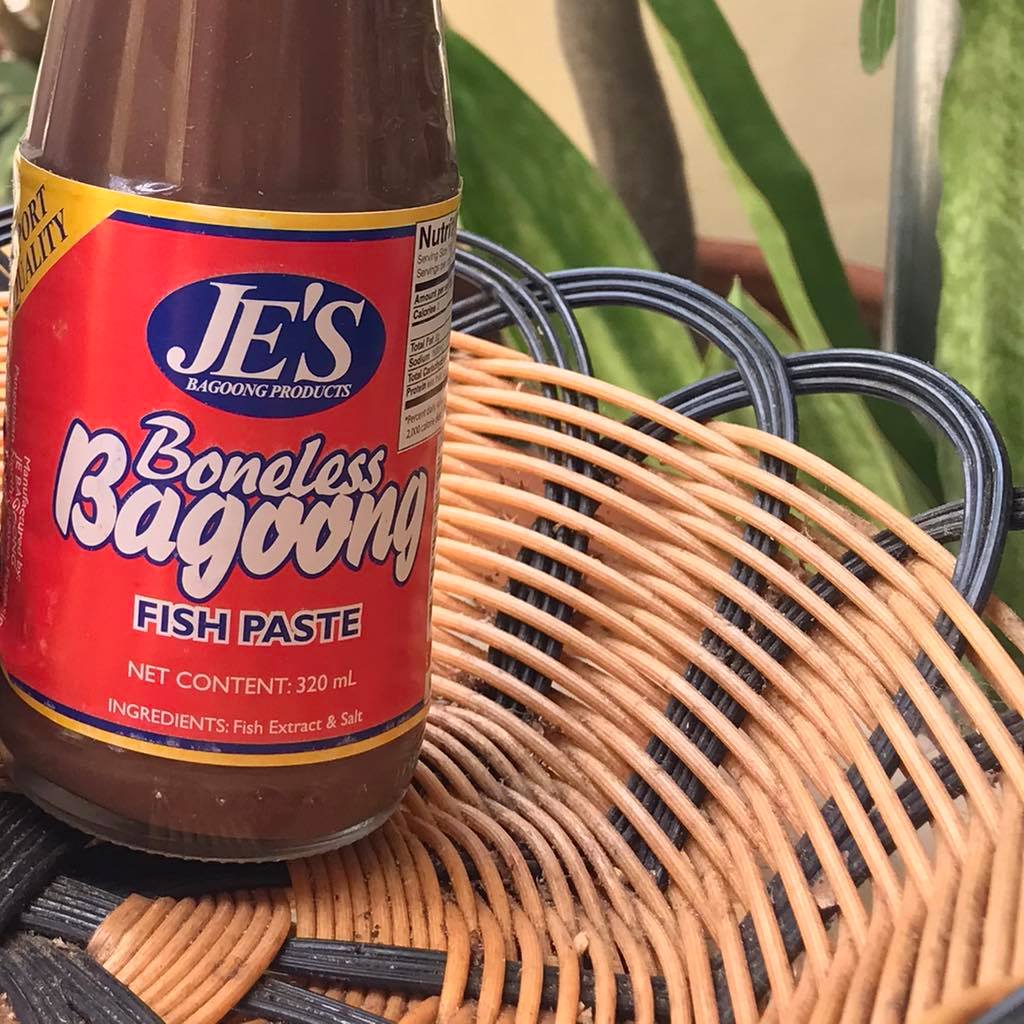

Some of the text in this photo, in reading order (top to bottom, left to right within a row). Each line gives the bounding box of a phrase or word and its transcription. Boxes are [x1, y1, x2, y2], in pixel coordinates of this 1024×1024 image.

[14, 208, 68, 304] UALITY
[166, 281, 366, 383] JE'S
[186, 376, 352, 400] BAGOONG PRODUCTS
[134, 411, 387, 499] Boneless
[54, 418, 427, 602] Bagoong
[133, 594, 363, 647] FISH PASTE
[127, 661, 358, 695] NET CONTENT: 320 mL
[107, 697, 364, 735] INGREDIENTS: Fish Extract & Salt
